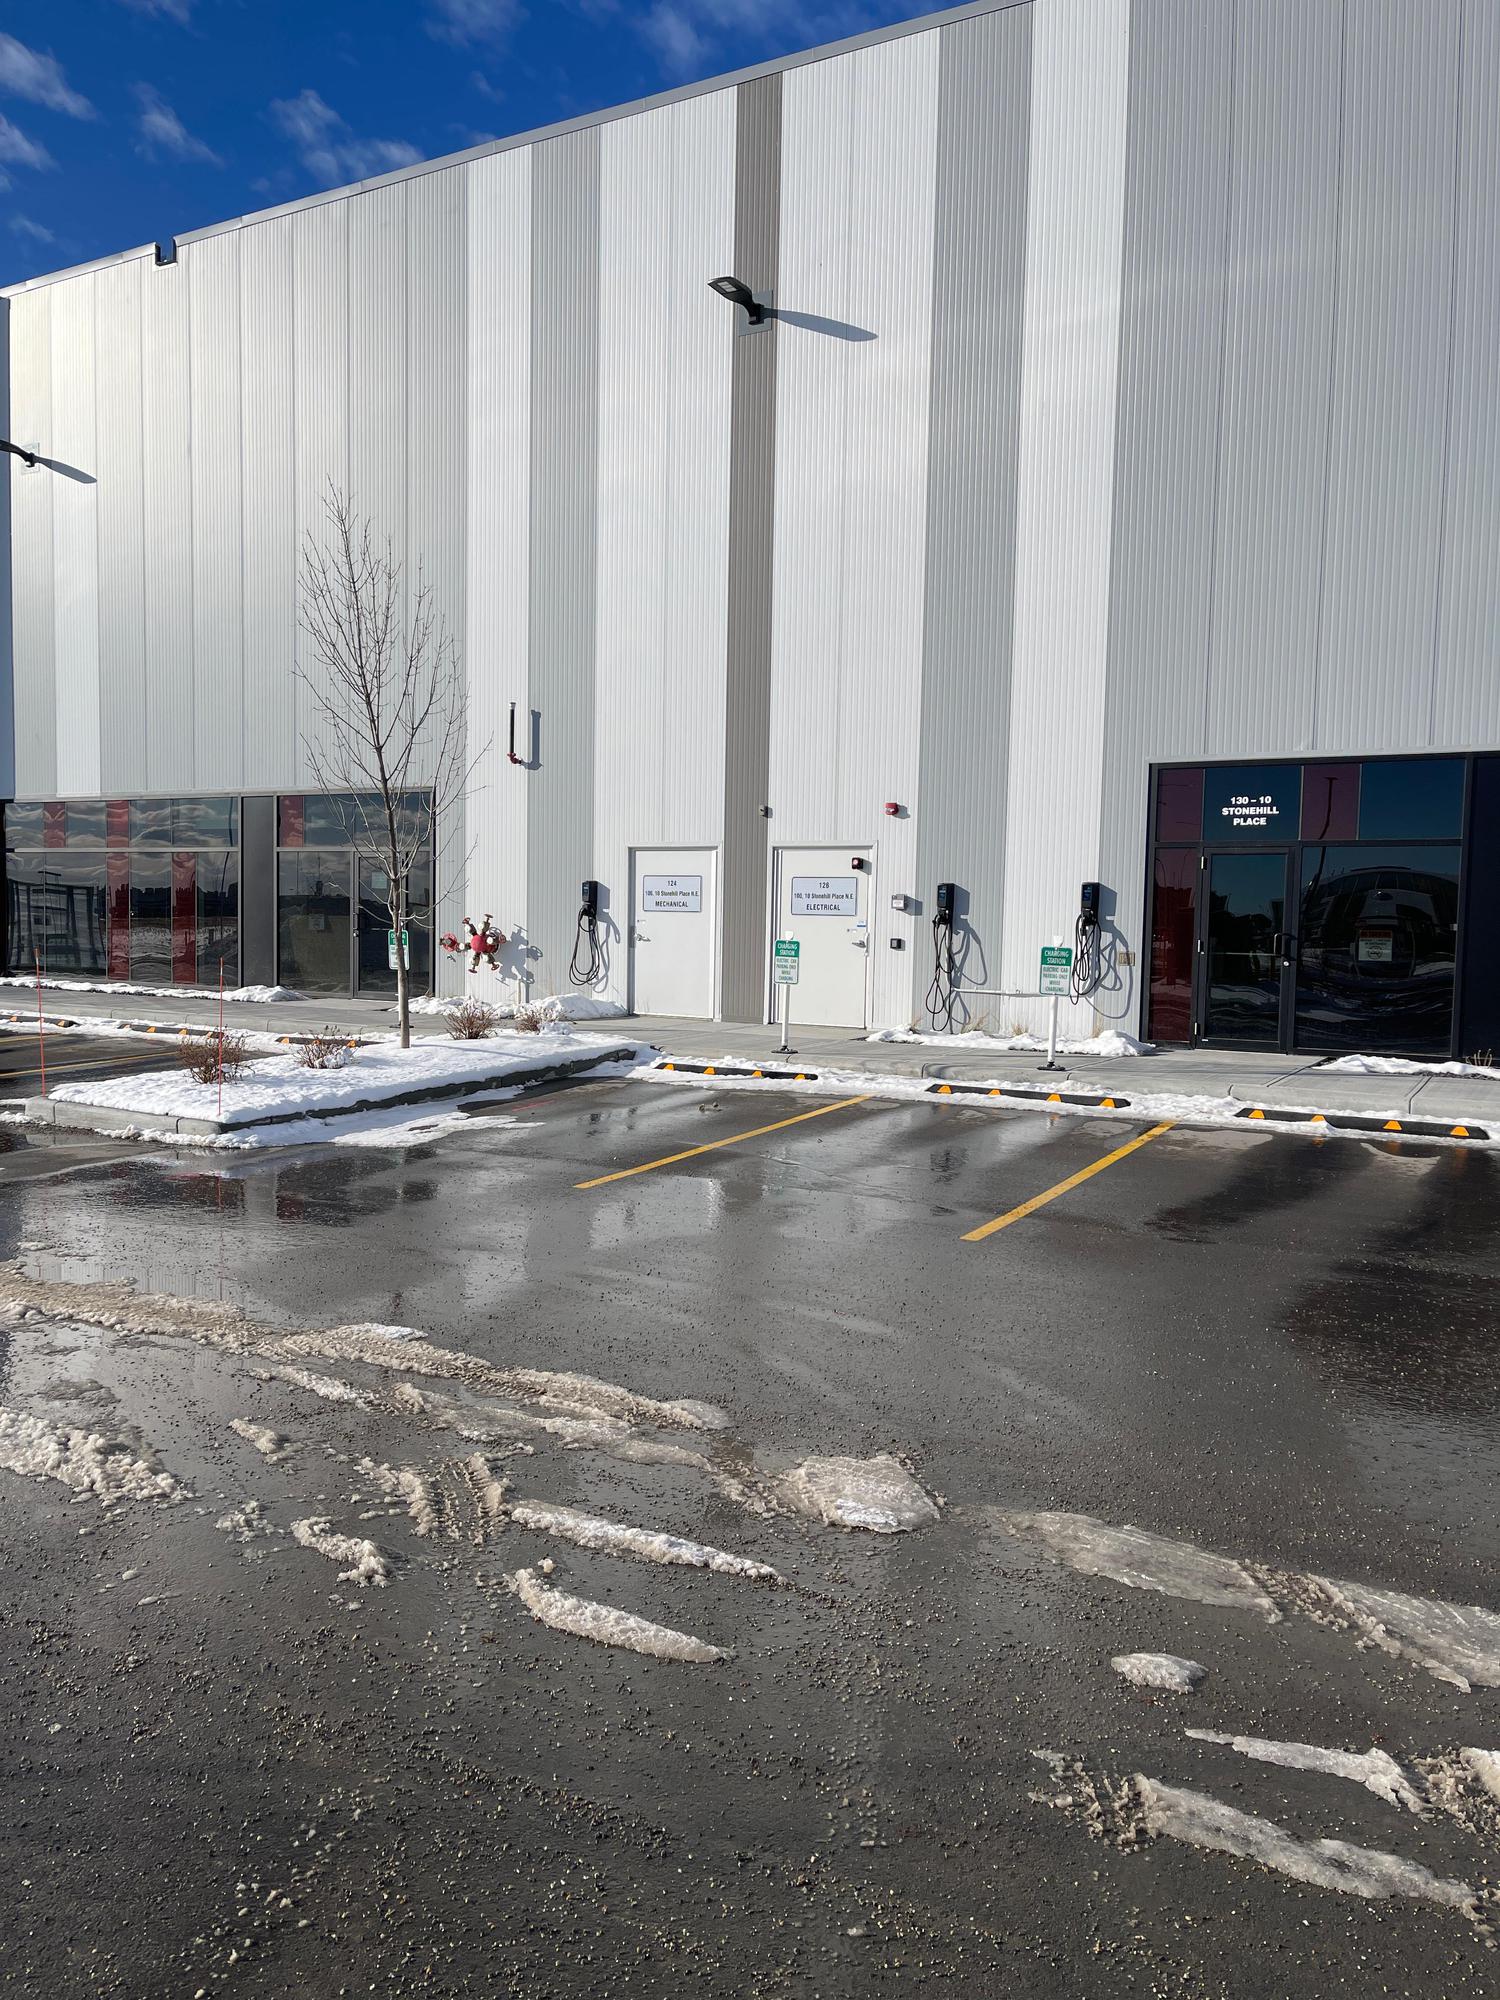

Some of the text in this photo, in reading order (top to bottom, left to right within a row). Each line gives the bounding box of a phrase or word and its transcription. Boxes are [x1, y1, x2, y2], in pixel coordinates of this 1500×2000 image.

[1231, 796, 1249, 804] 130
[1259, 795, 1272, 804] 10
[1221, 806, 1280, 816] STONEHILL
[1233, 817, 1267, 826] PLACE
[832, 892, 844, 900] Place
[655, 900, 689, 908] MECHANICAL
[806, 903, 841, 911] ELECTRICAL
